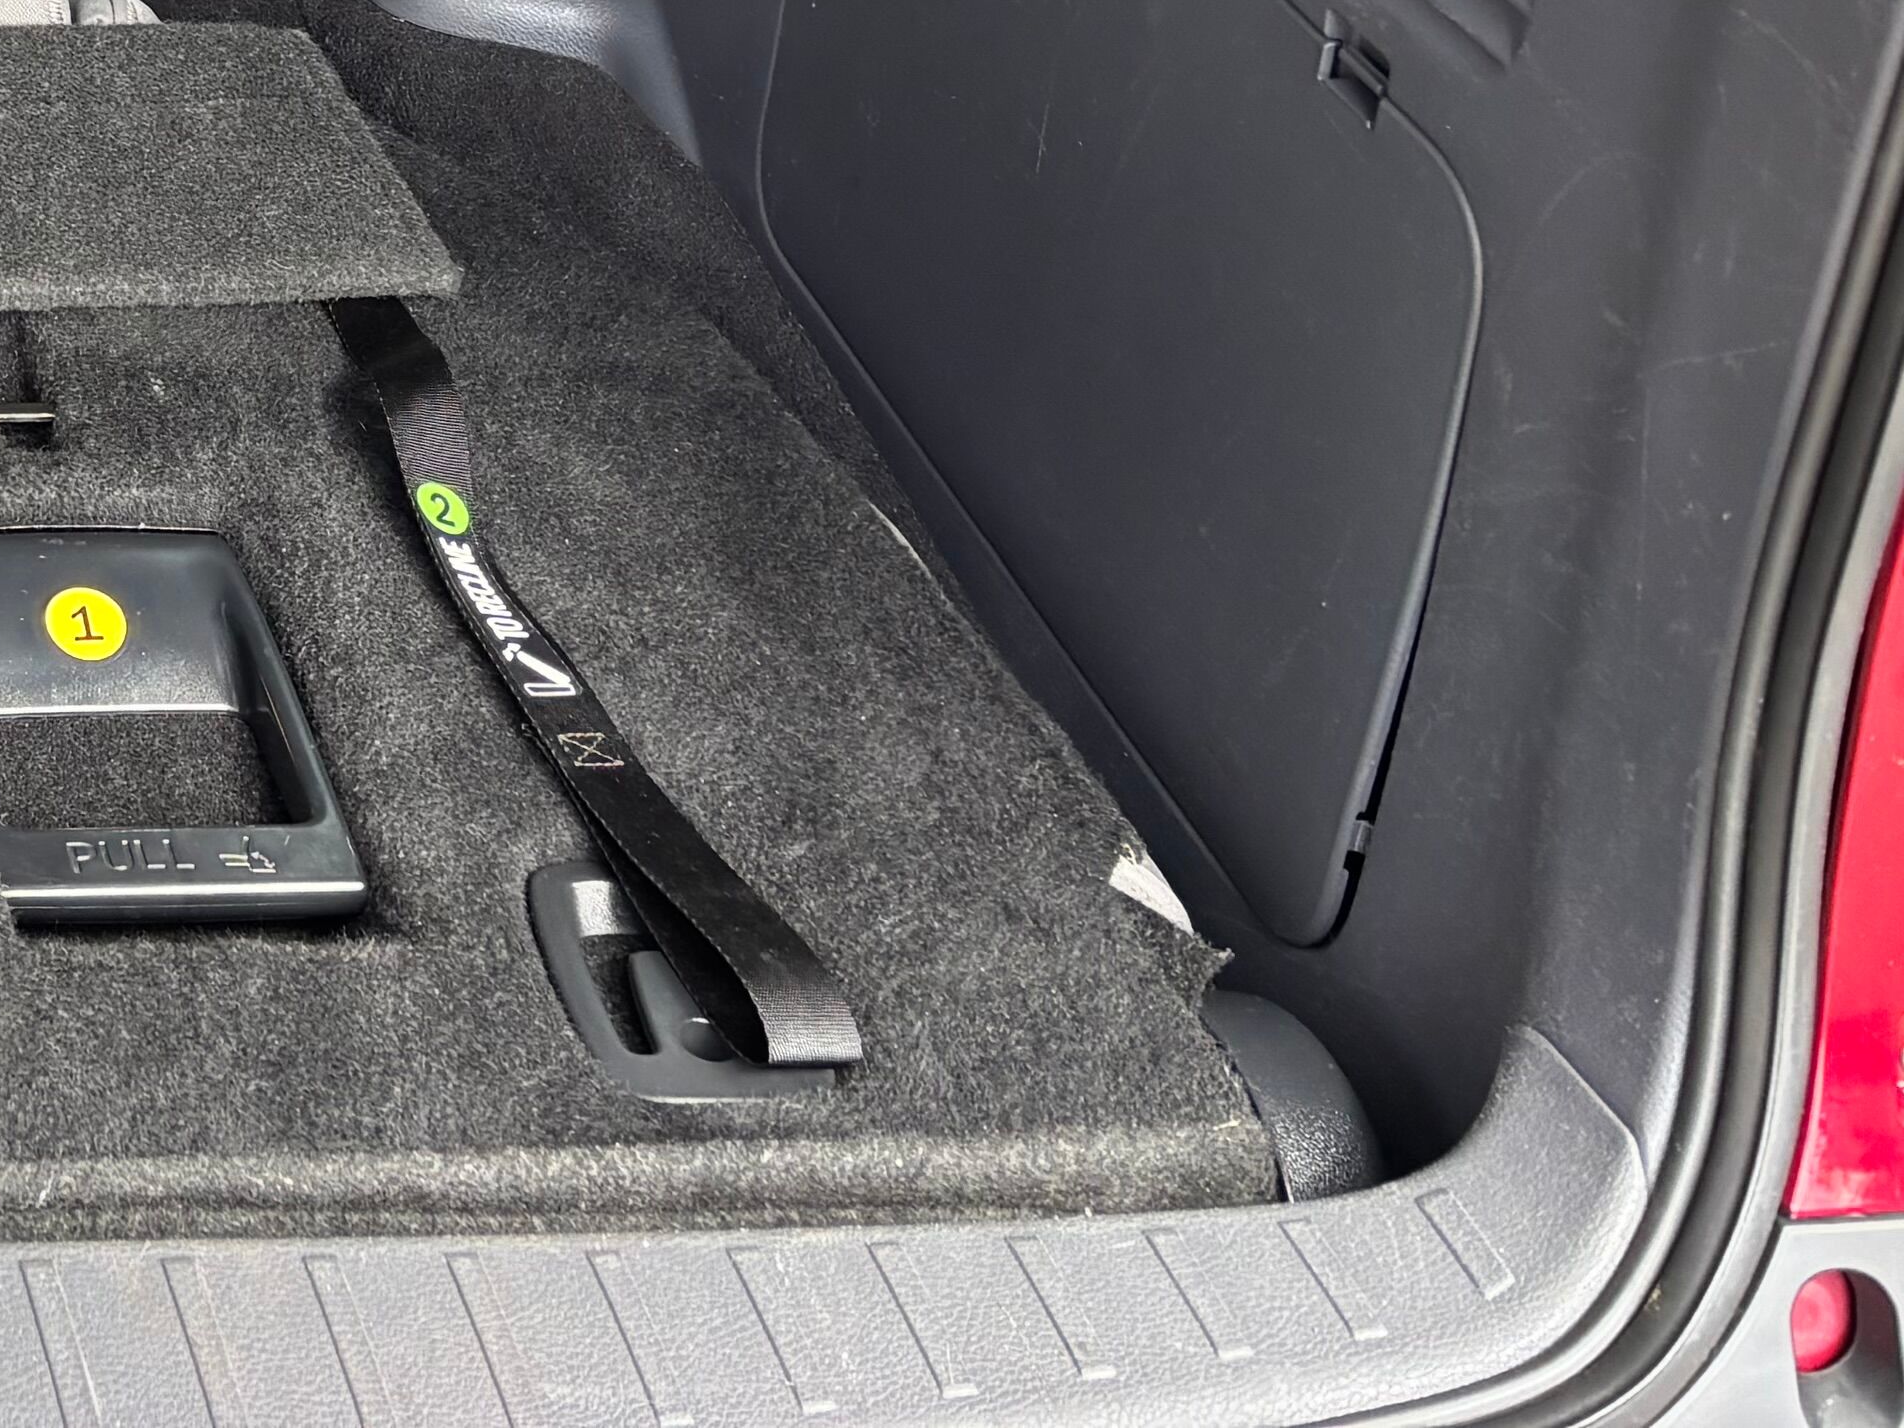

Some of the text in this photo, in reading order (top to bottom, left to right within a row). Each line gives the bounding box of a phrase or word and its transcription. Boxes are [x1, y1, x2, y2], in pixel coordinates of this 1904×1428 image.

[430, 493, 456, 527] 2
[70, 605, 105, 642] 1
[65, 838, 196, 875] PULL
